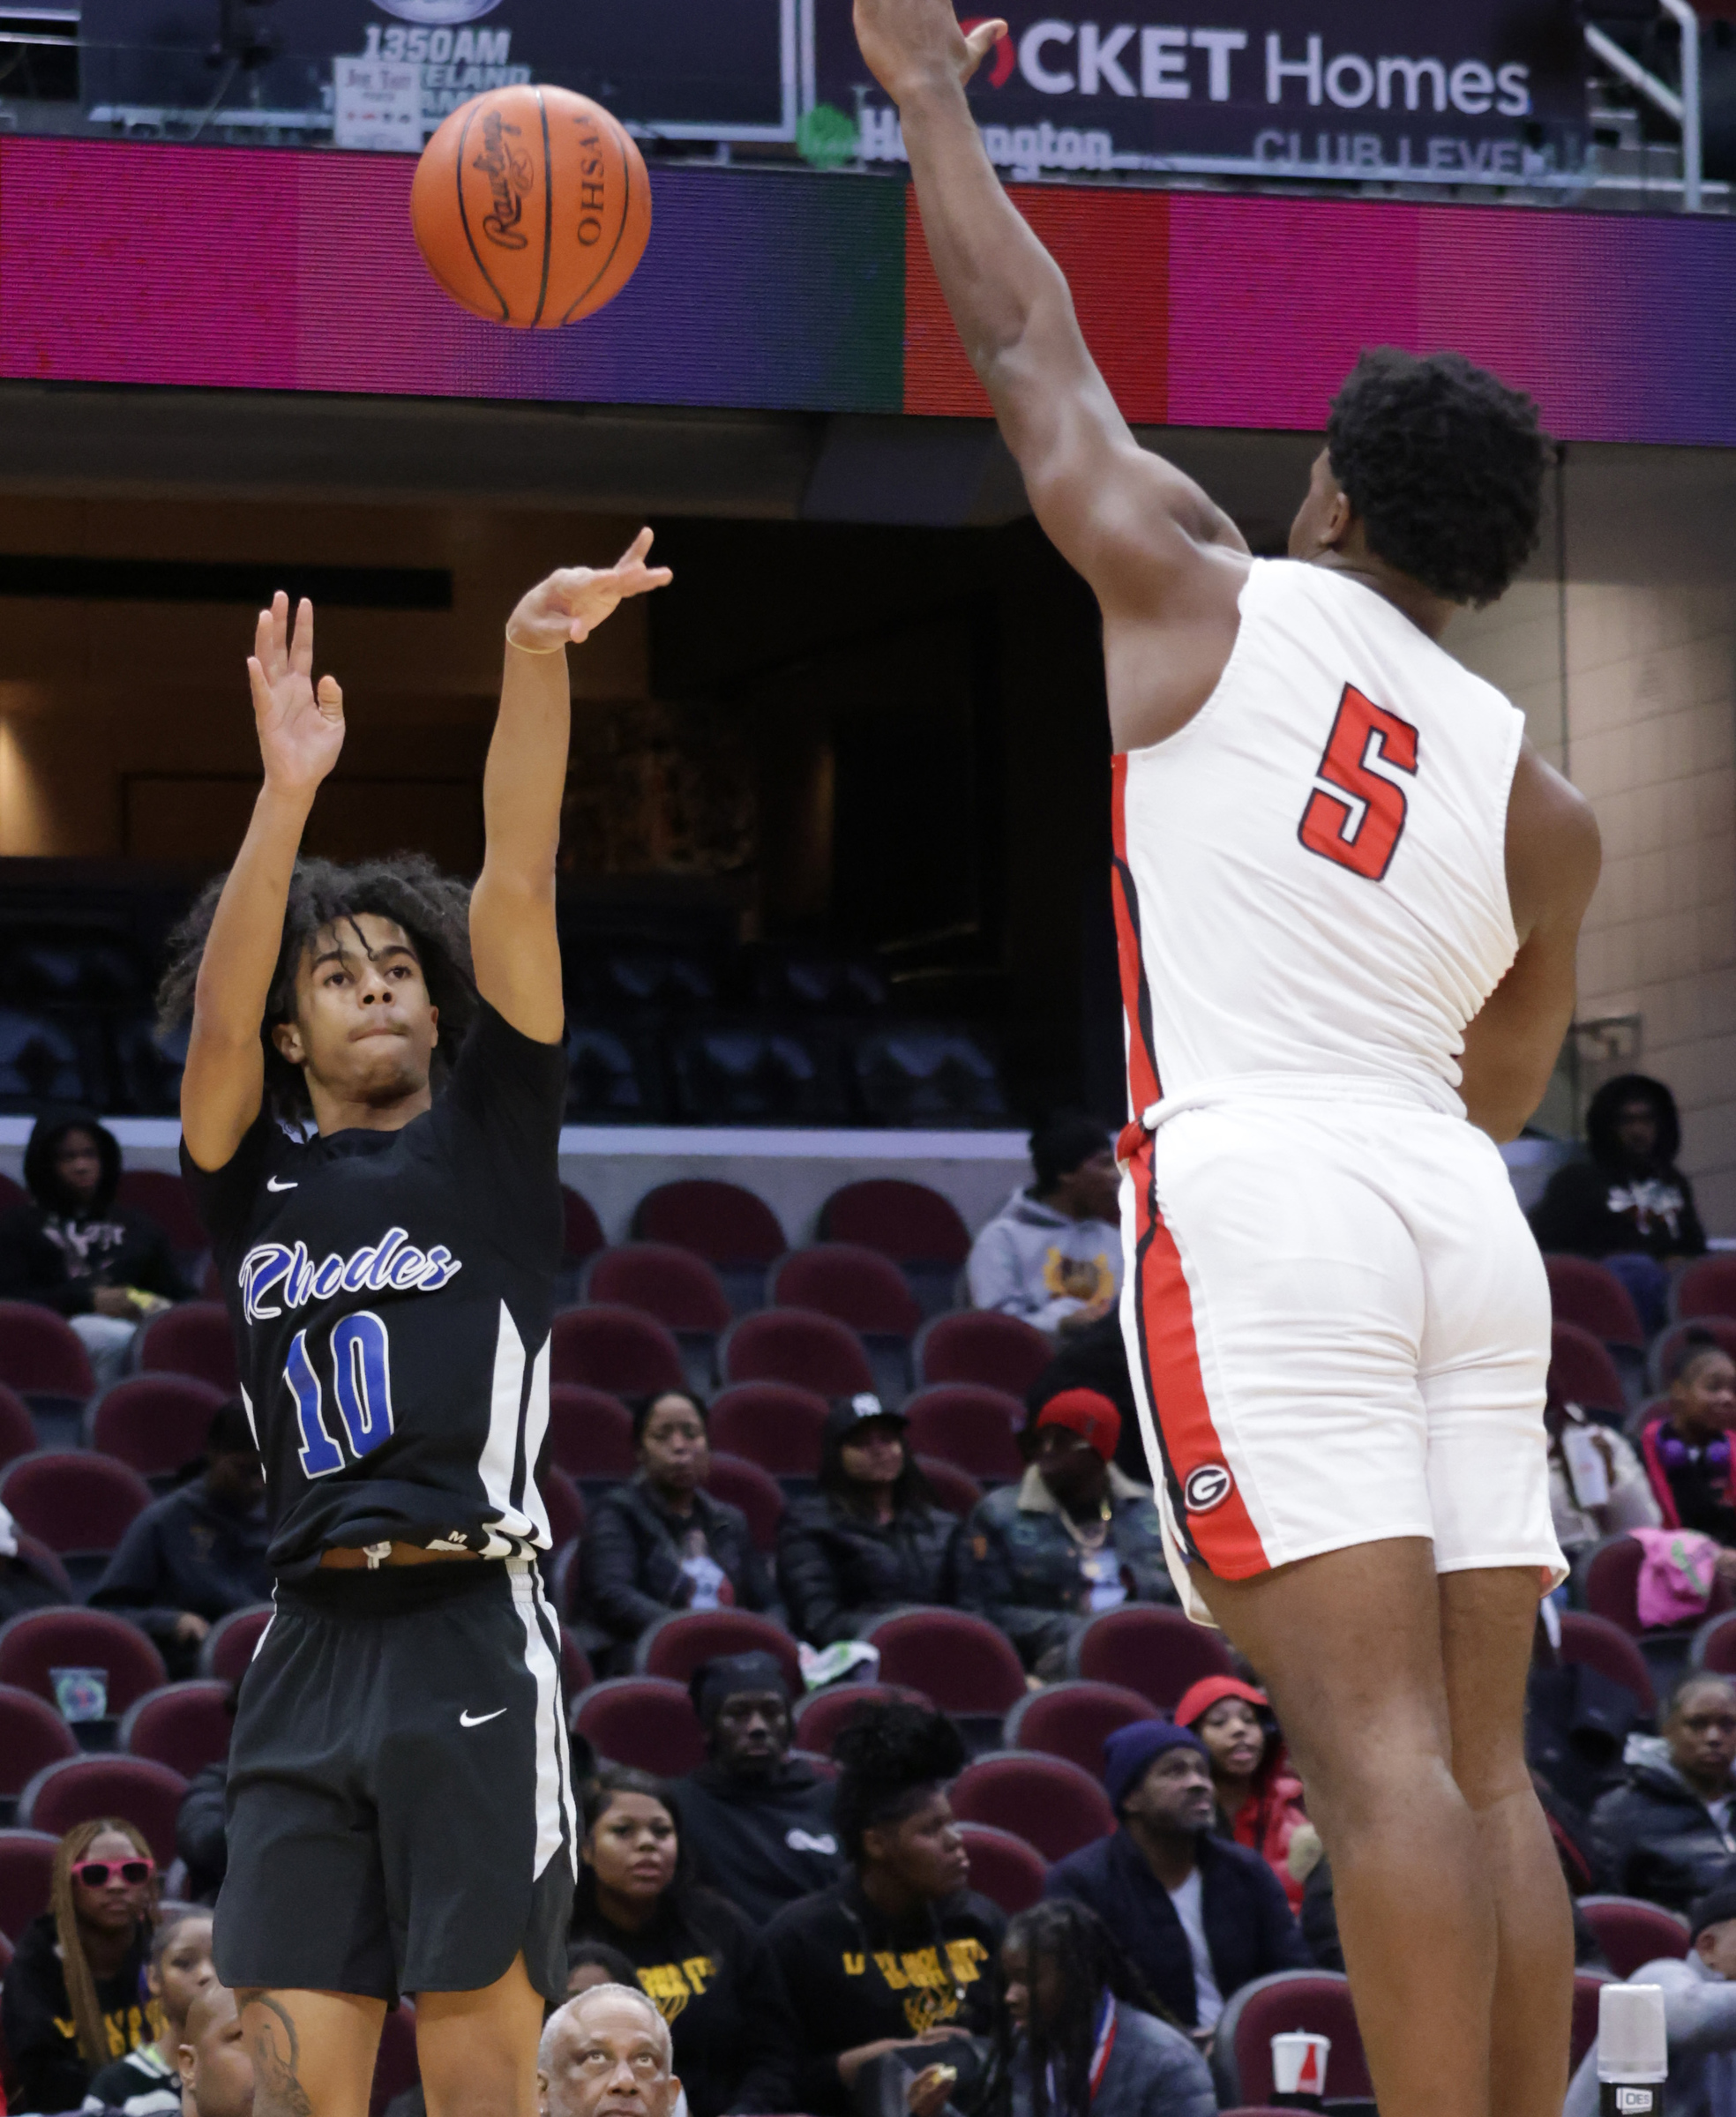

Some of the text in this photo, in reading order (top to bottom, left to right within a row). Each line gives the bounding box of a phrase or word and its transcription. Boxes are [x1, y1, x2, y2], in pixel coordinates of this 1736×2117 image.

[364, 25, 512, 65] 1350AM
[960, 19, 1531, 116] CKET Homes
[576, 115, 605, 247] OHSAA
[1298, 681, 1419, 882] 5
[239, 1227, 461, 1325] Rhodes
[282, 1310, 394, 1479] 10
[1188, 1466, 1229, 1507] G
